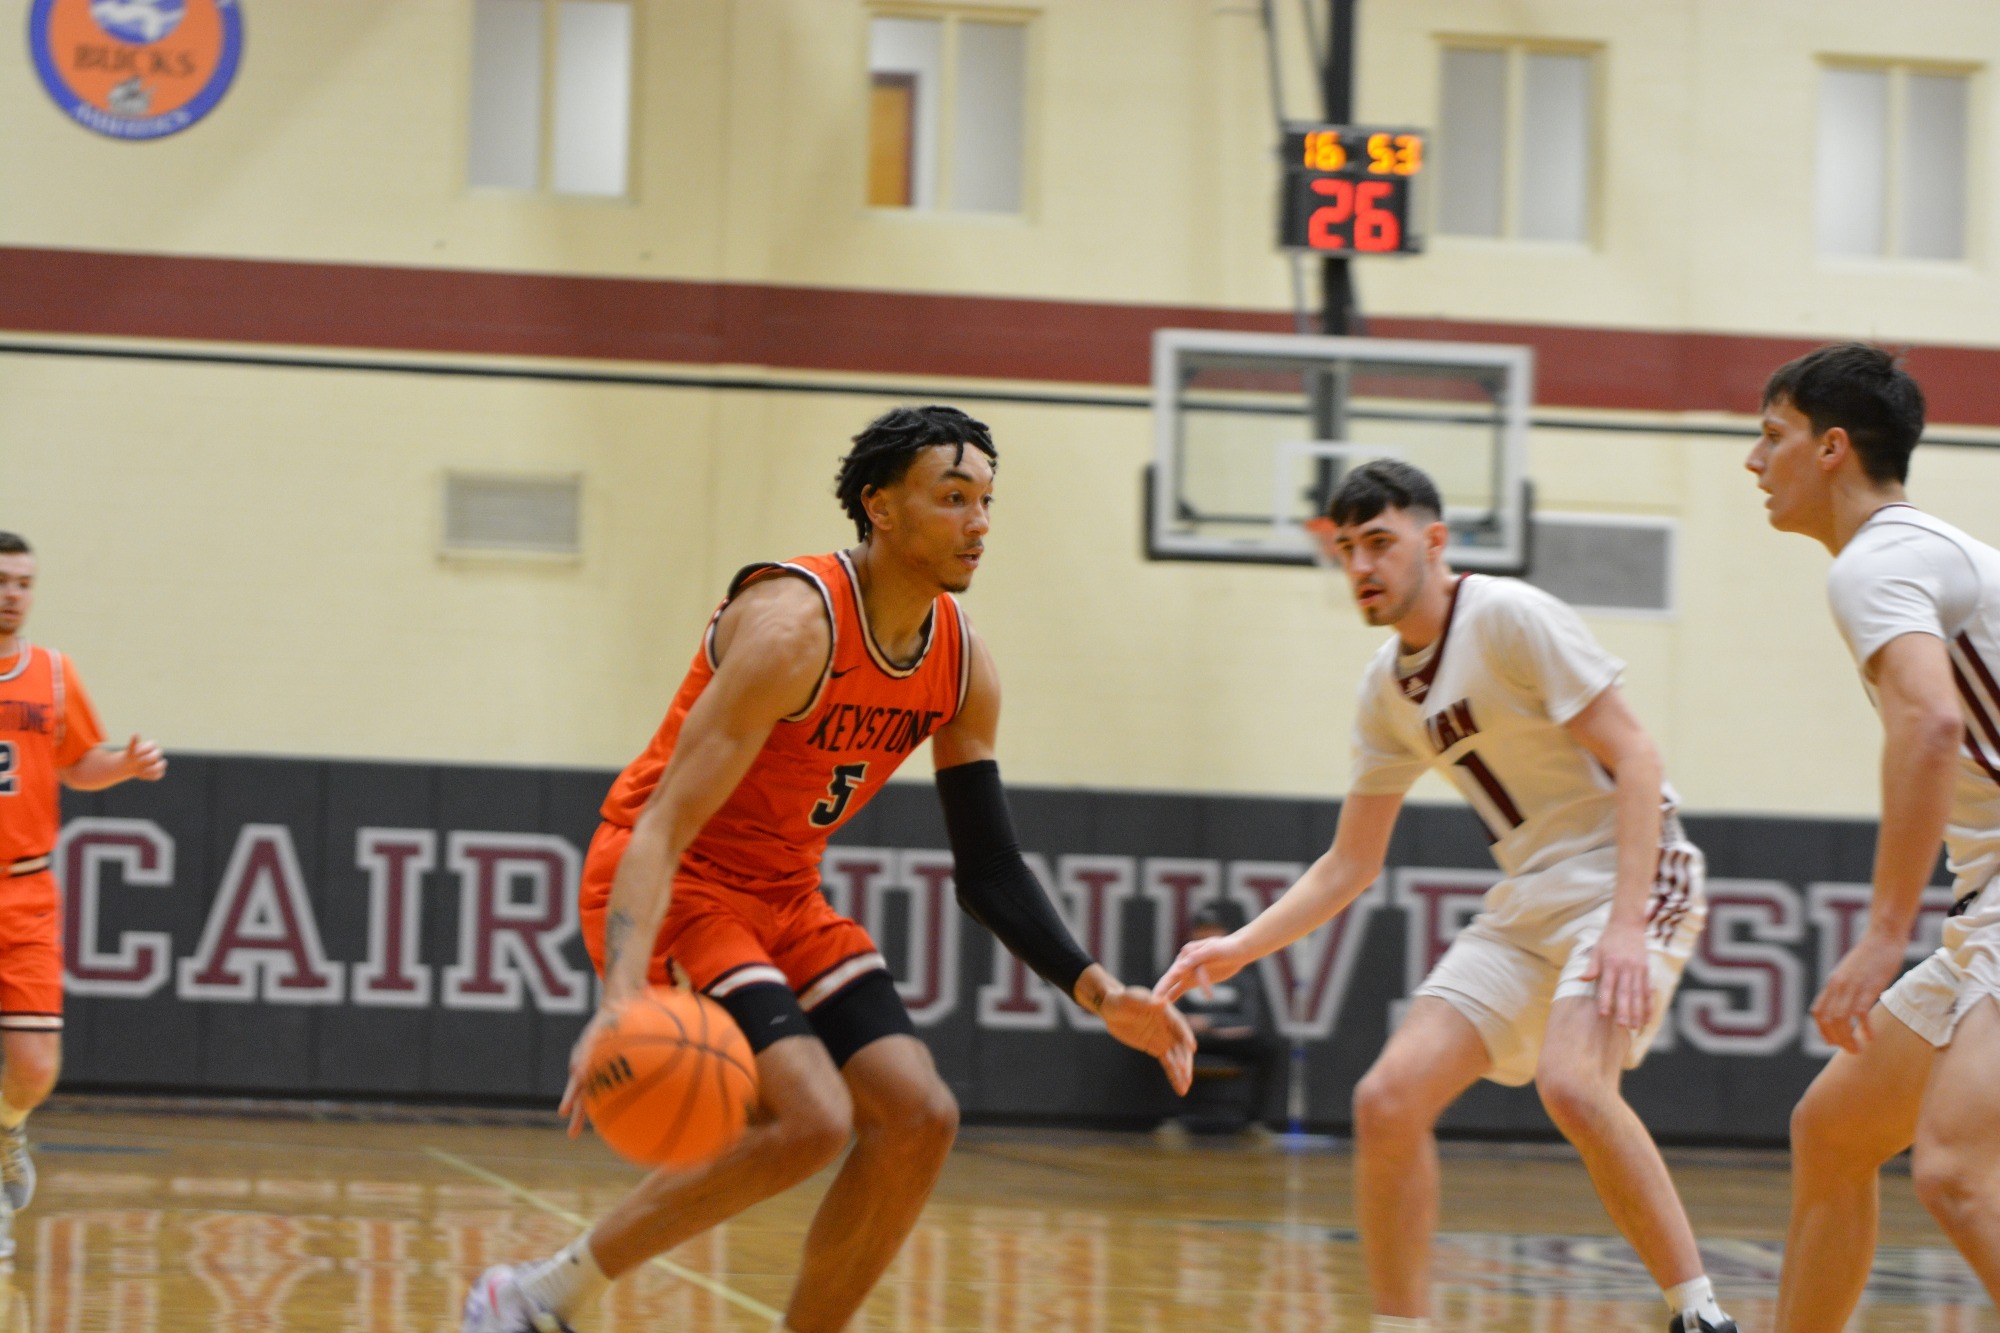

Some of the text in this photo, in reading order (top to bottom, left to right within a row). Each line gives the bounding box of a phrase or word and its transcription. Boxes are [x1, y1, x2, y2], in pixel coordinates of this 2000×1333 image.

[1303, 130, 1424, 176] 16 53
[1308, 177, 1400, 253] 26
[806, 703, 943, 754] KEYSTONE
[808, 761, 870, 828] 5
[58, 815, 603, 1016] CAIR
